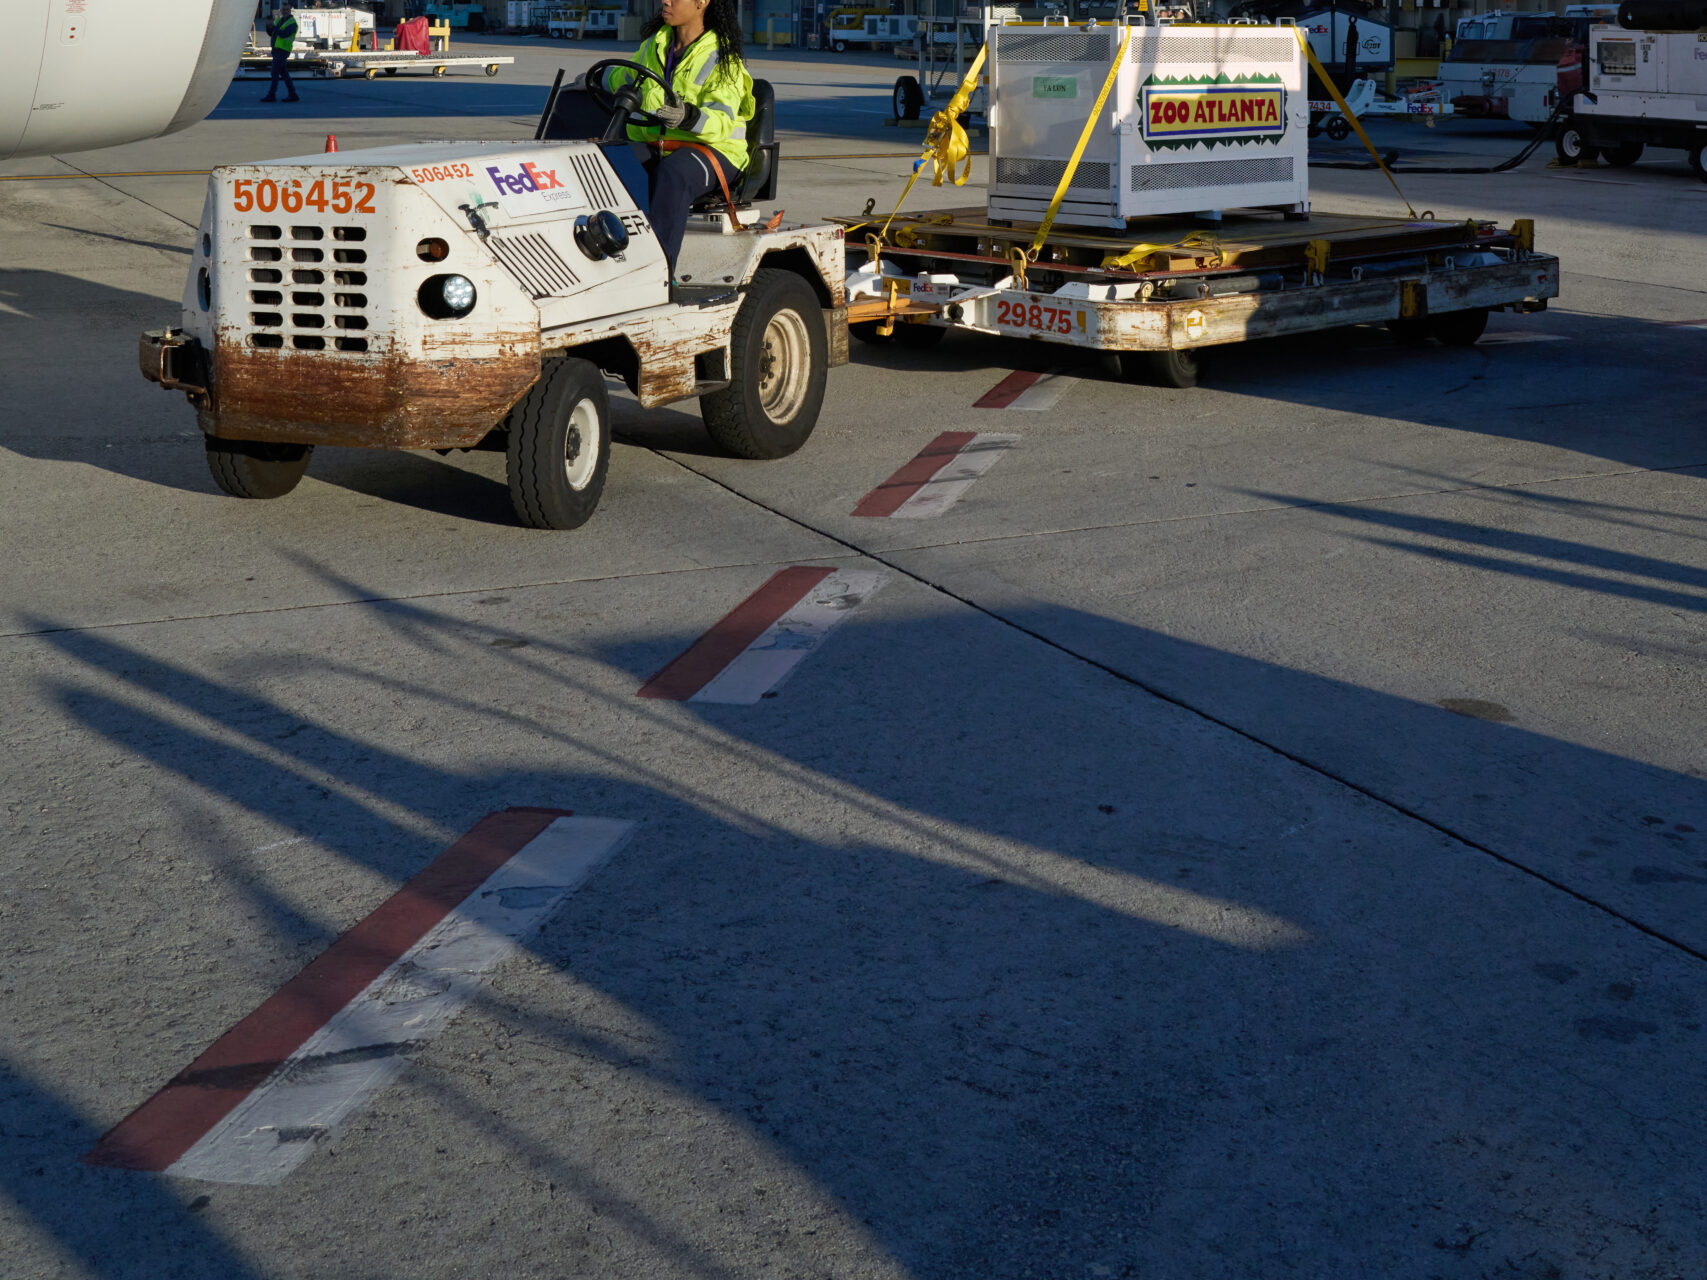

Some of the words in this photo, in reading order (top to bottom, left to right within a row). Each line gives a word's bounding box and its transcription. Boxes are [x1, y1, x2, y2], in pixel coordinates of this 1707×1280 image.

[1150, 100, 1190, 125] ZOO
[1194, 98, 1278, 123] ATLANTA
[1407, 103, 1433, 113] FedEx
[411, 162, 474, 184] 506452
[485, 161, 566, 197] FedEx
[233, 178, 376, 214] 506452
[541, 190, 572, 203] Express
[913, 282, 933, 293] FedEx
[996, 300, 1072, 335] 29875
